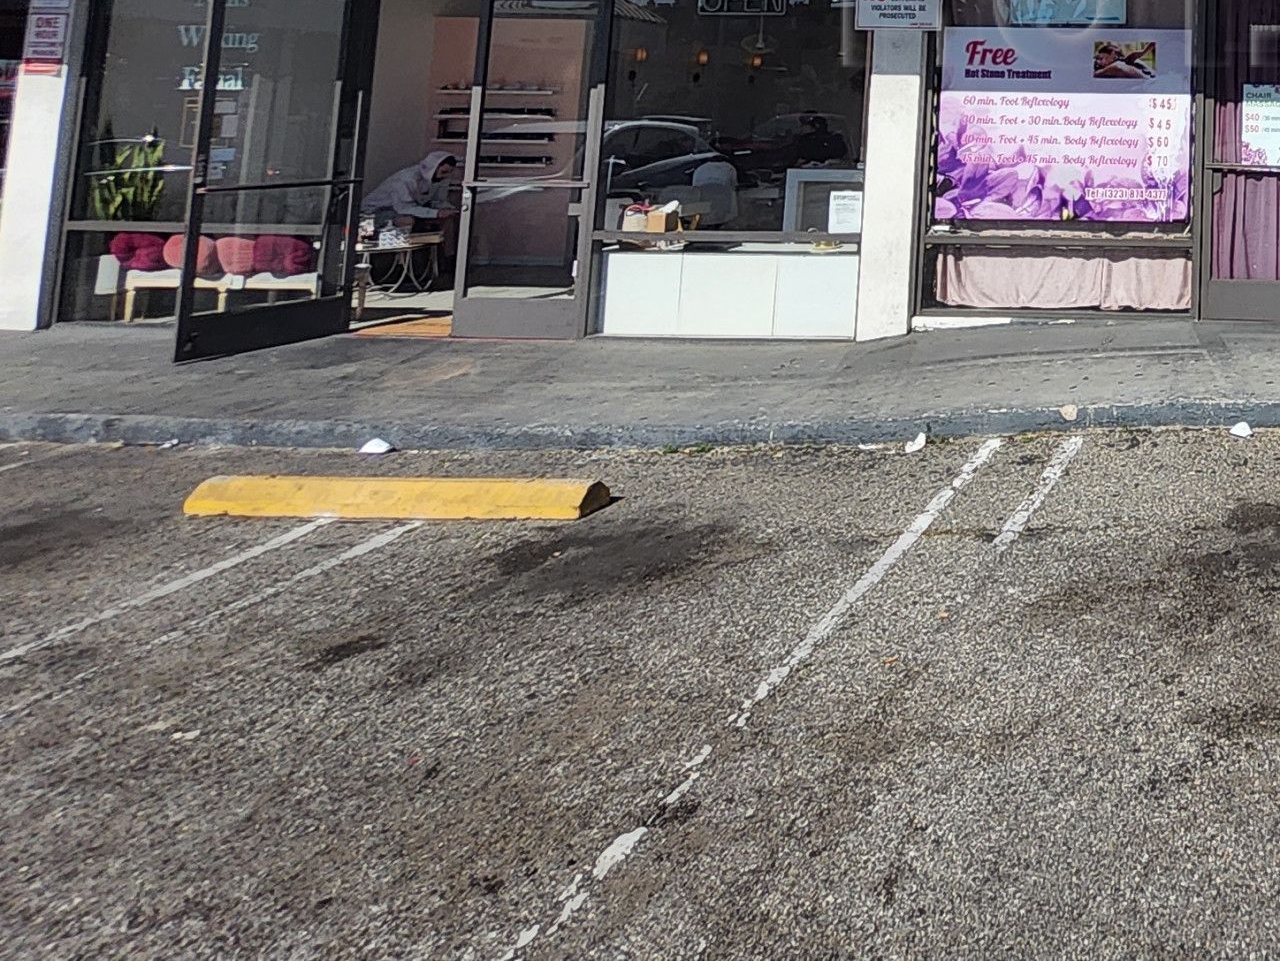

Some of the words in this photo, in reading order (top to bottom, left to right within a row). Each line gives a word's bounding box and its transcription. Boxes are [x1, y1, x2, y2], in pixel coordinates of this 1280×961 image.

[878, 12, 917, 20] PROSECUTED
[177, 24, 260, 53] Wing
[966, 39, 1019, 66] Free
[177, 66, 245, 91] Faial
[965, 69, 979, 78] Hot
[981, 69, 1005, 79] Stone
[1007, 69, 1051, 79] Treatment
[963, 95, 976, 105] 60
[977, 96, 997, 105] min.
[1000, 96, 1019, 105] Foot
[1020, 96, 1070, 109] Reflexology
[963, 114, 976, 124] 30
[999, 115, 1018, 125] Foot
[1028, 115, 1041, 125] 30
[1062, 116, 1086, 128] Body
[1089, 116, 1138, 129] Reflexology
[1245, 113, 1260, 121] $40
[1245, 124, 1260, 133] $50
[999, 134, 1018, 144] Foot
[1063, 136, 1087, 147] Body
[1089, 136, 1139, 148] Reflexology
[997, 153, 1016, 163] Foot
[1062, 154, 1086, 167] Body
[1088, 154, 1138, 167] Reflexology
